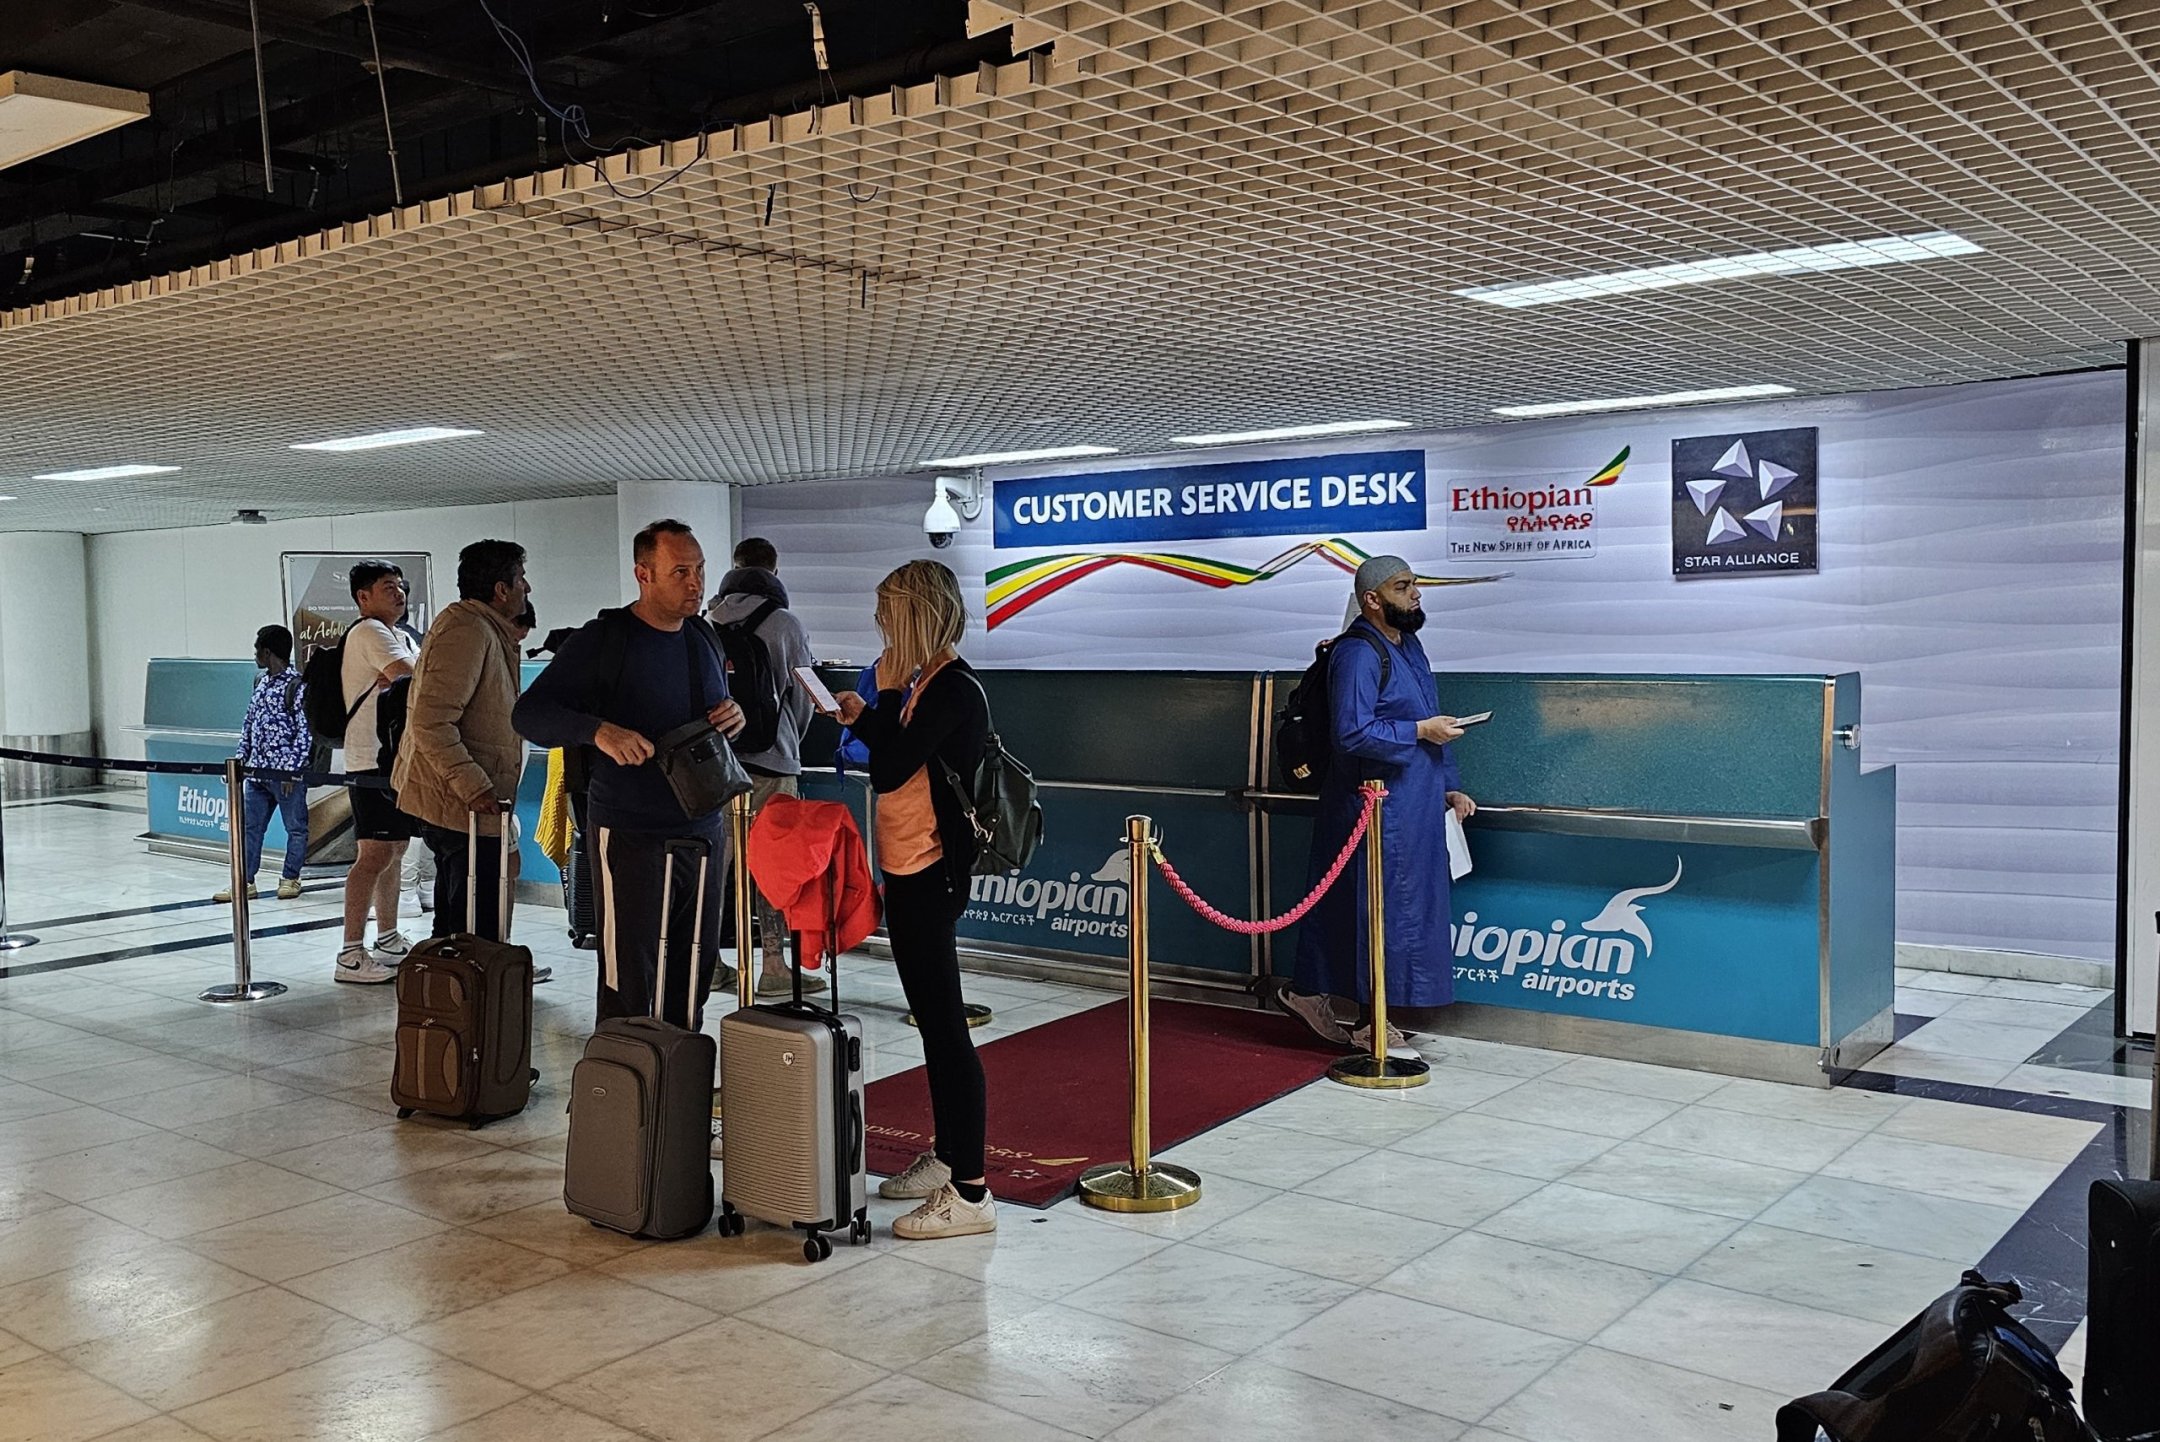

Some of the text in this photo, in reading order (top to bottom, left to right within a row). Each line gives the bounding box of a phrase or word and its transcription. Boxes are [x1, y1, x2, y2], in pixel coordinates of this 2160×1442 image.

[1013, 471, 1417, 525] CUSTOMER SERVICE DESK
[1452, 484, 1592, 515] Ethiopian
[1450, 542, 1470, 553] THE
[1473, 541, 1496, 553] NEW
[1500, 540, 1532, 551] SPIRIT
[1553, 538, 1591, 550] AFRICA
[1684, 552, 1799, 567] STAR ALLIANCE
[969, 868, 1127, 919] thiopian
[1051, 913, 1128, 938] airports
[1450, 911, 1634, 975] iopian
[1521, 968, 1635, 1001] airports
